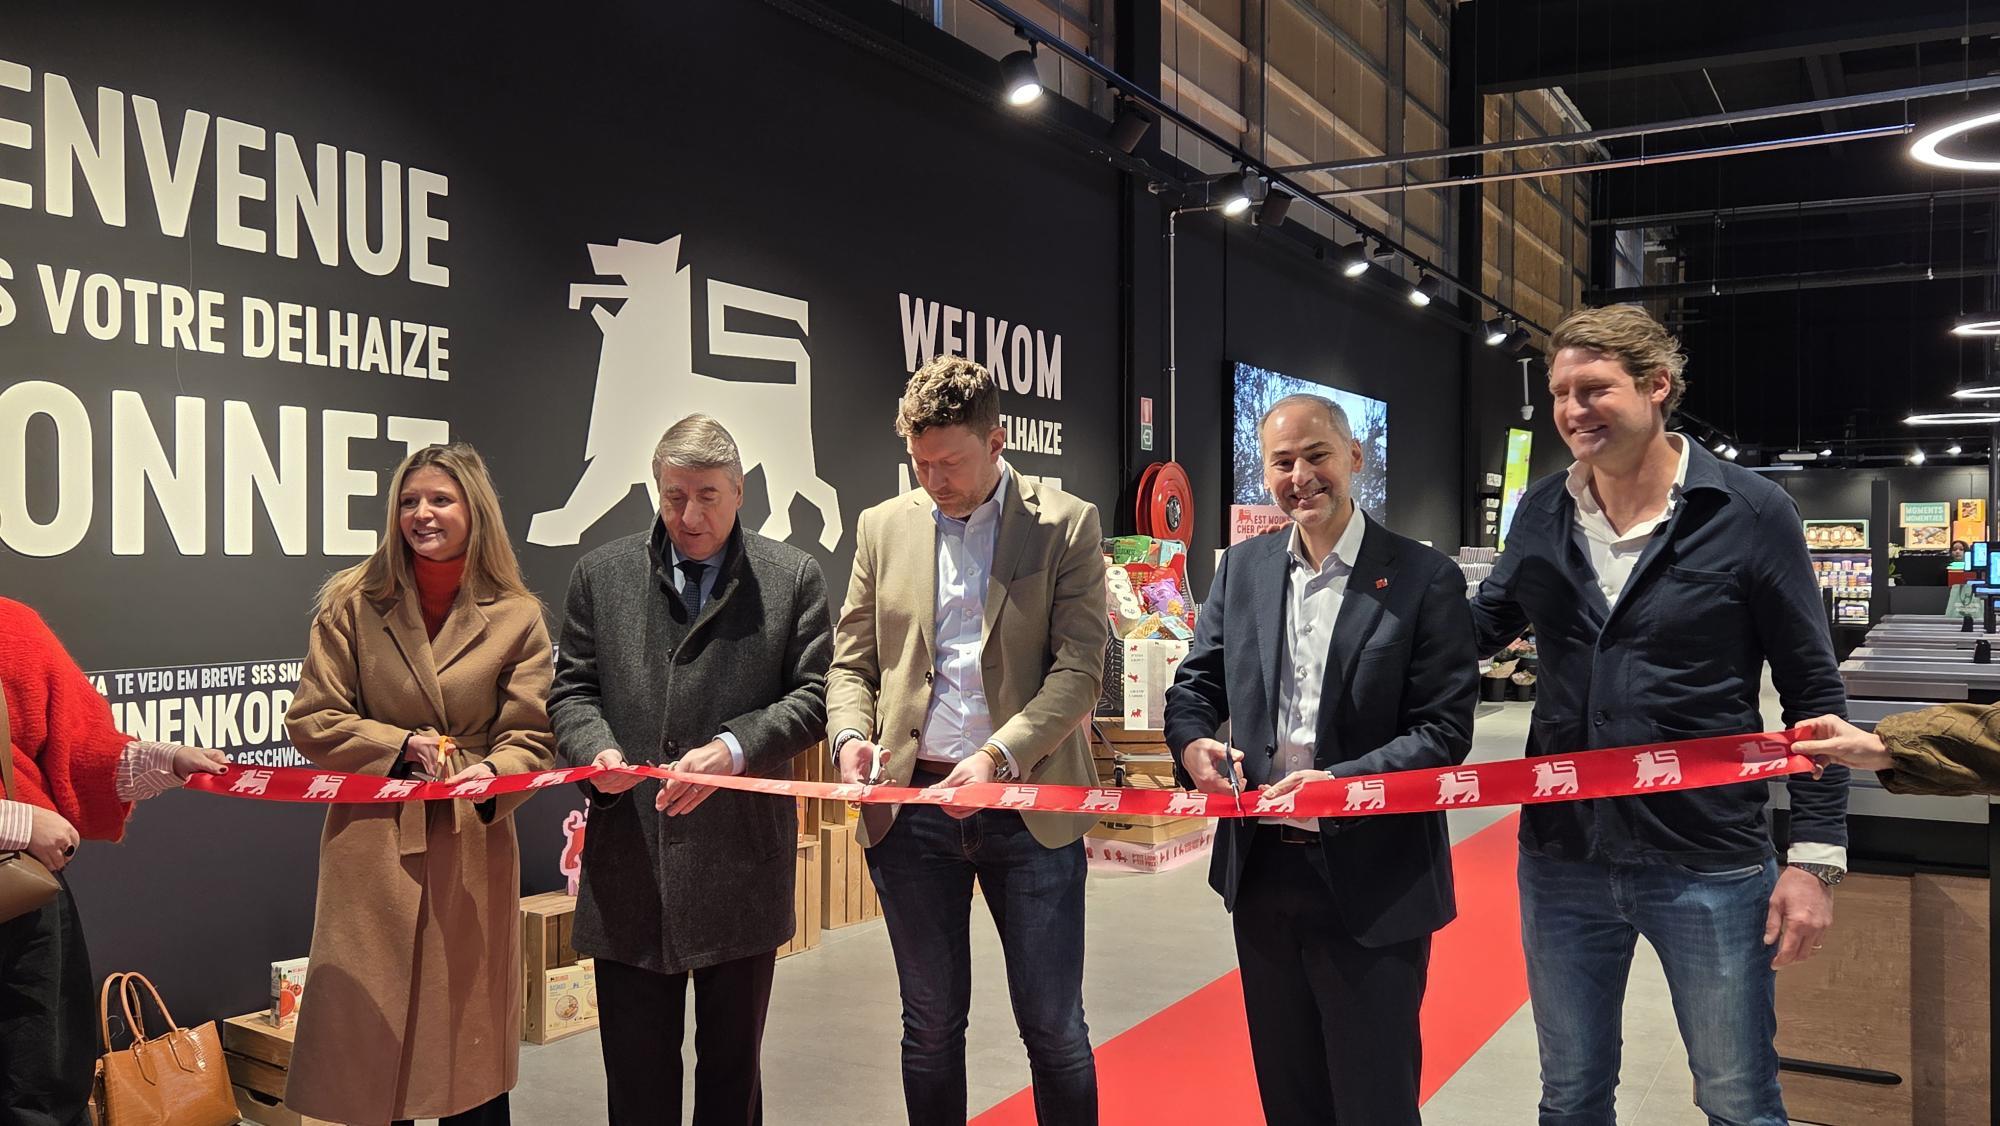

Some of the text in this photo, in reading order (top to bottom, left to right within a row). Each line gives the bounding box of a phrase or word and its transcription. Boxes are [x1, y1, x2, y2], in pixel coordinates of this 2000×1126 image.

[36, 263, 225, 353] VOTRE
[242, 296, 450, 382] DELHAIZE
[1905, 506, 1944, 514] MOMENTS
[1254, 515, 1267, 525] EST
[1237, 525, 1255, 533] CHER
[114, 672, 134, 695] TE
[137, 670, 174, 694] VEJO
[176, 668, 198, 691] EM
[201, 665, 246, 689] BREVE
[251, 664, 276, 685] SES
